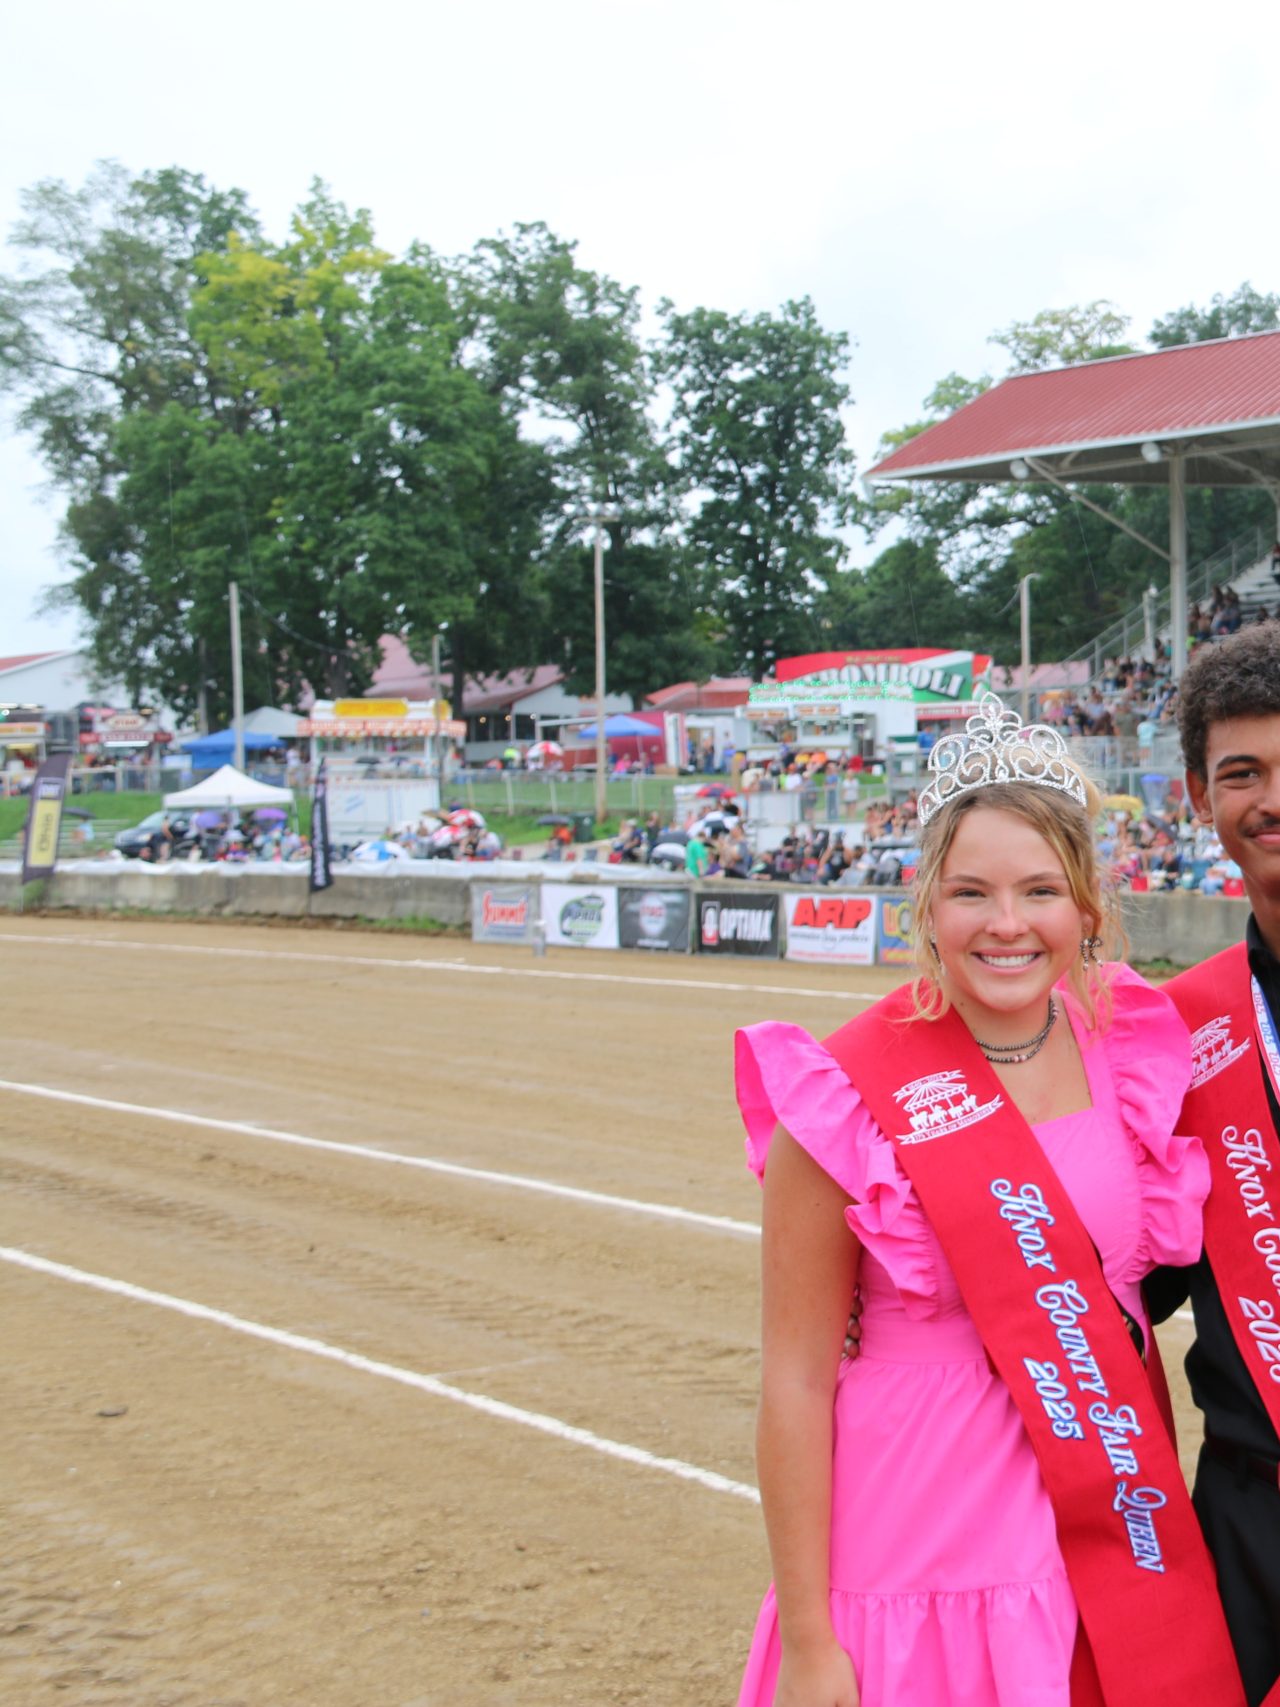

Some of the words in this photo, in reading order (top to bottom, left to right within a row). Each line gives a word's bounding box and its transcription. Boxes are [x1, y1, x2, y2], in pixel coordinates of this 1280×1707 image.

[802, 663, 965, 700] ROMBOLI
[719, 908, 775, 942] OPTIMA
[792, 897, 872, 929] ARP
[1221, 1125, 1275, 1222] KNOX
[990, 1178, 1056, 1273] KNOX
[1035, 1279, 1109, 1399] COUNTY
[1023, 1357, 1086, 1440] 2025
[1087, 1401, 1143, 1476] FAIR
[1113, 1480, 1168, 1574] QUEEN
